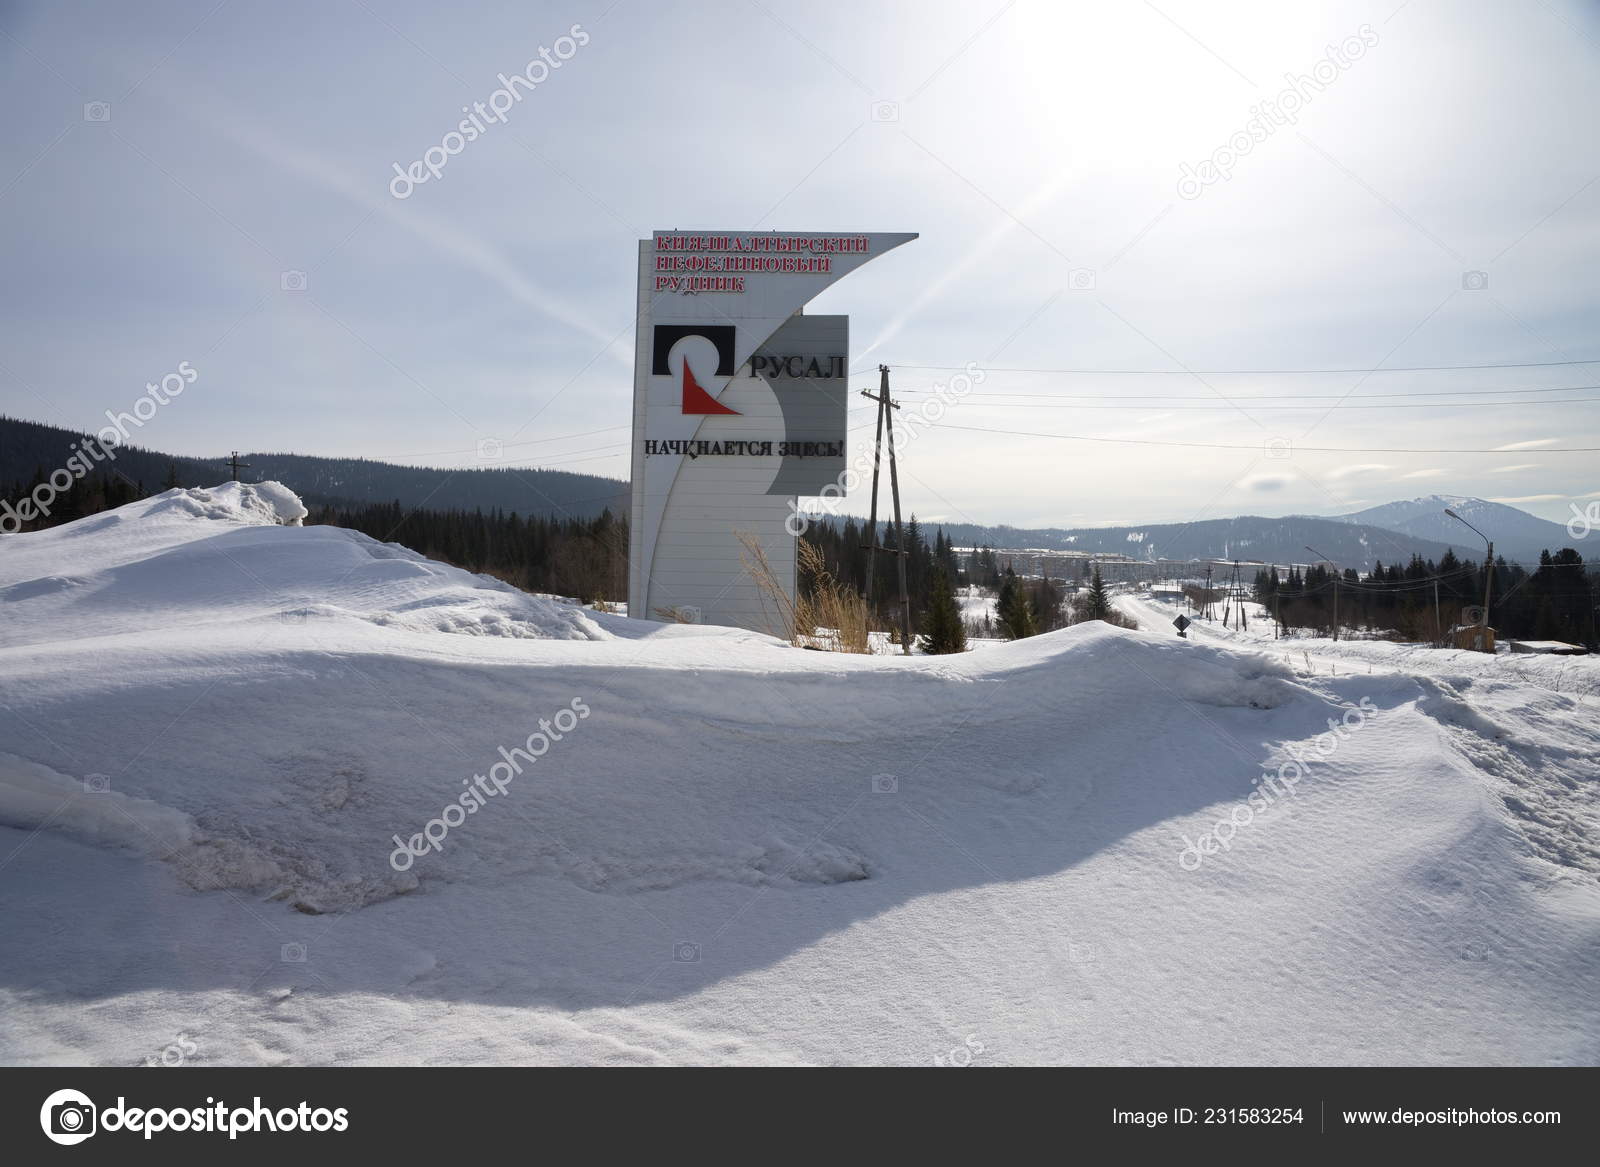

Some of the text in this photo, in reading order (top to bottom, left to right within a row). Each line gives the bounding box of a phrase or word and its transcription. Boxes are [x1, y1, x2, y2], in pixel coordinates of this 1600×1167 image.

[655, 235, 869, 253] КИЯ-ШАЛТЫРСКИЙ
[655, 255, 832, 273] НЕФЕЛИНОВЫЙ
[655, 276, 745, 295] РУДНИК
[749, 355, 848, 379] РУСАЛ
[778, 440, 844, 459] ЗДЕСЬ!
